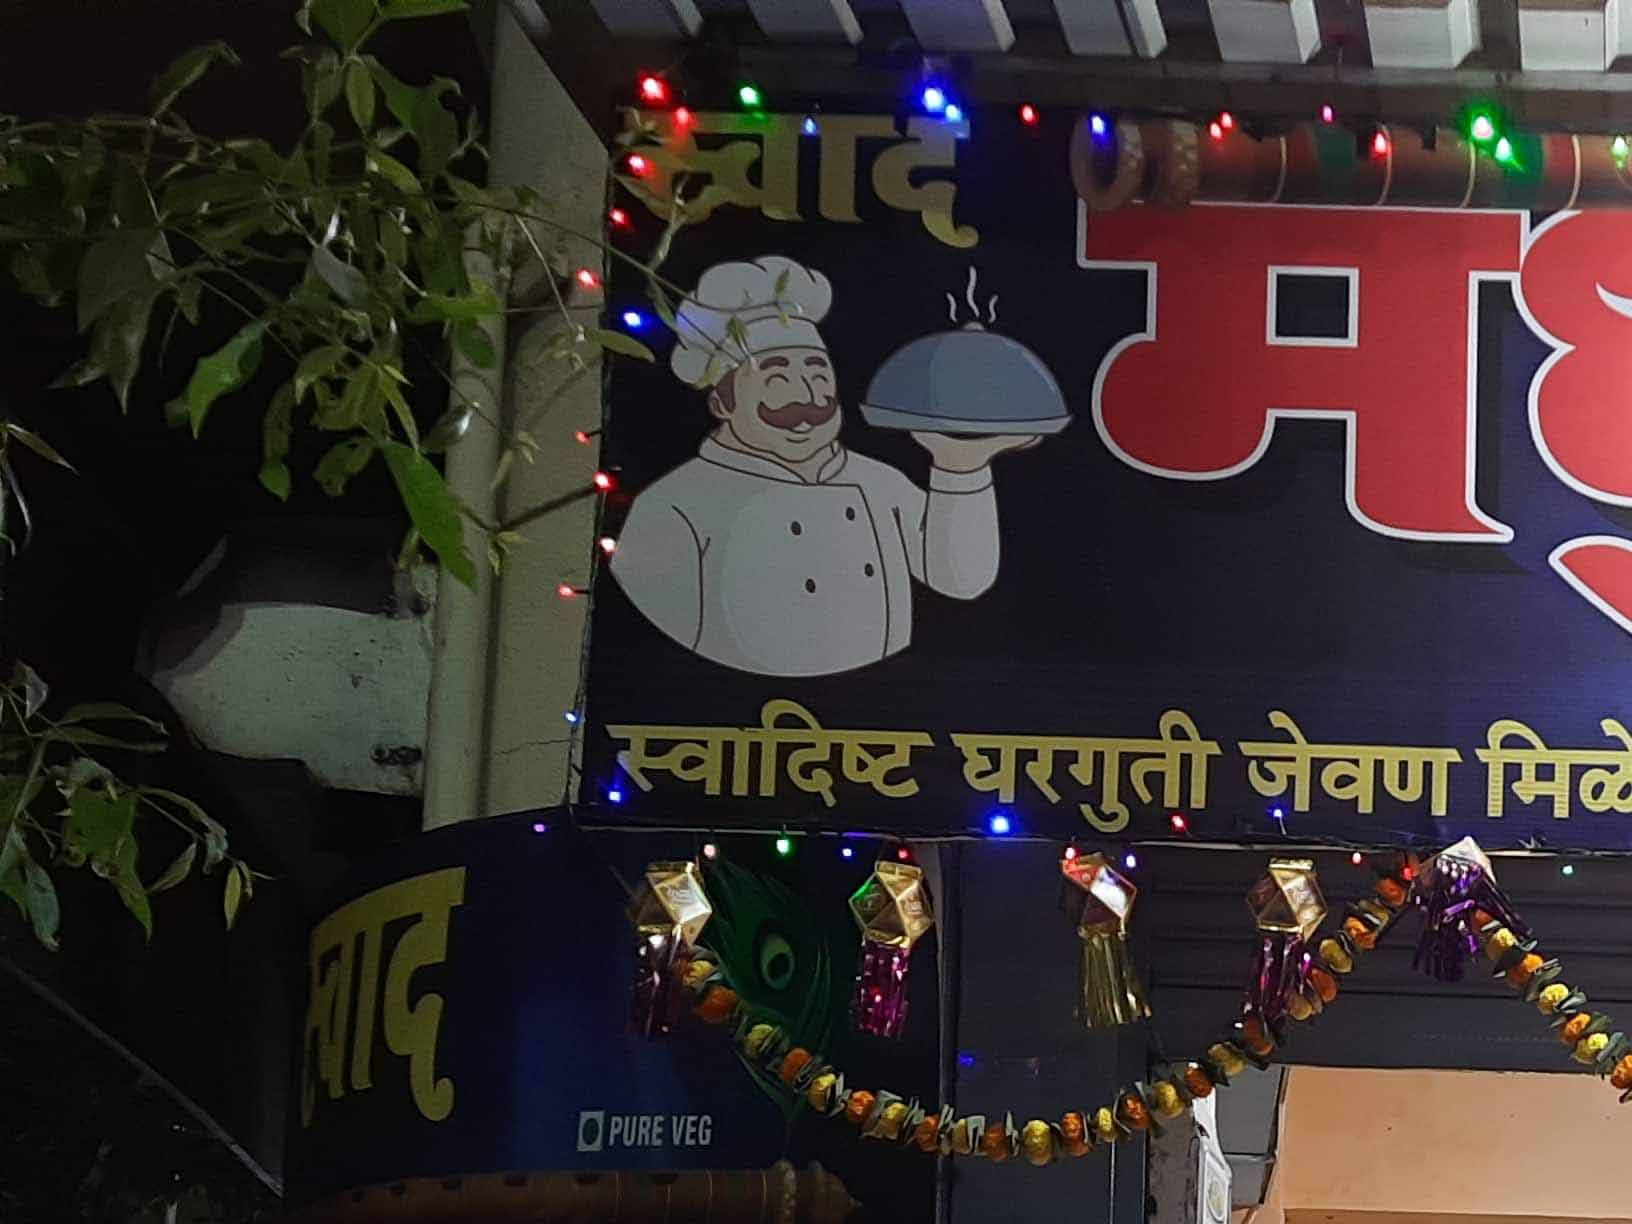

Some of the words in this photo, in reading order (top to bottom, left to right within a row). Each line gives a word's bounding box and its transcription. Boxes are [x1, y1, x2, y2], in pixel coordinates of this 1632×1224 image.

[604, 697, 936, 807] स्वादिष्ट
[951, 709, 1224, 832] घरगुती
[1238, 709, 1462, 818] जेवण
[608, 1115, 665, 1147] PURE
[672, 1115, 713, 1146] VEG
